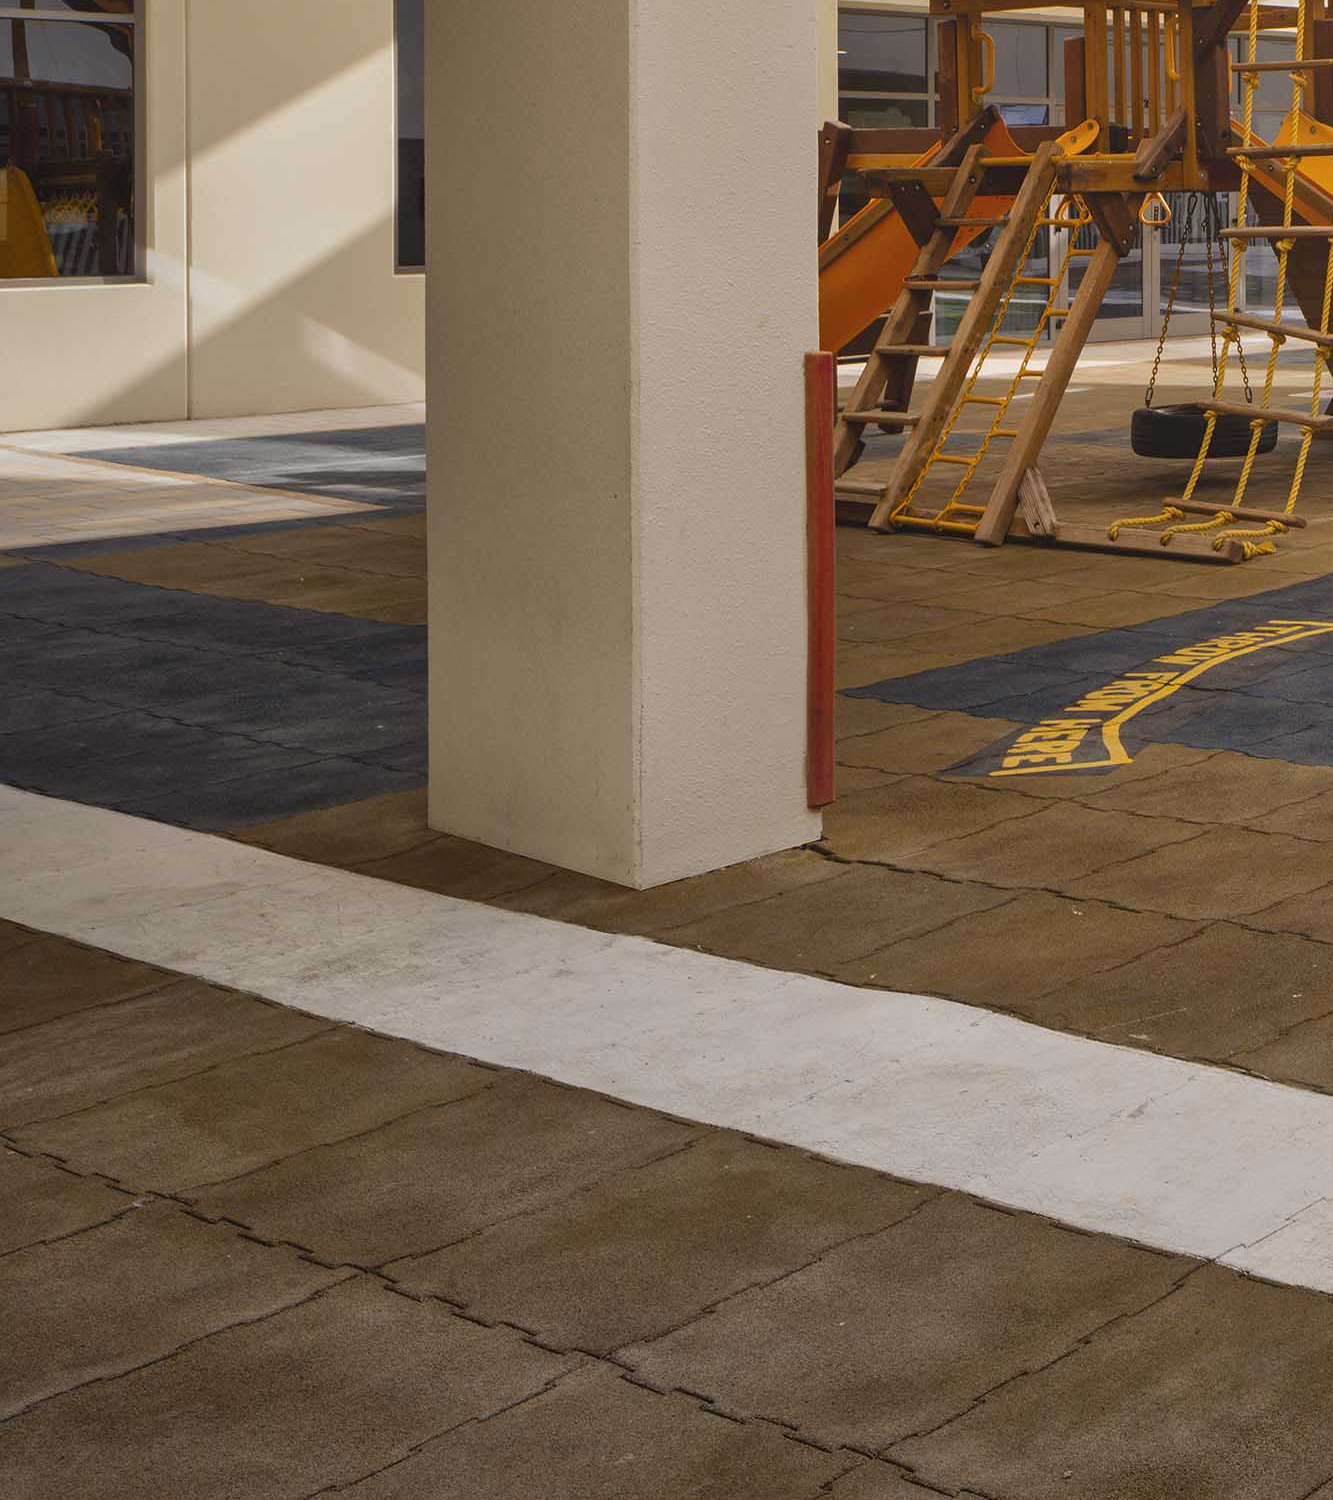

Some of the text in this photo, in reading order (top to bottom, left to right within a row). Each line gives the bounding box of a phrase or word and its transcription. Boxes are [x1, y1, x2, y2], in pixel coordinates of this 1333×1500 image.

[1002, 626, 1305, 768] THROW FROM HERE
